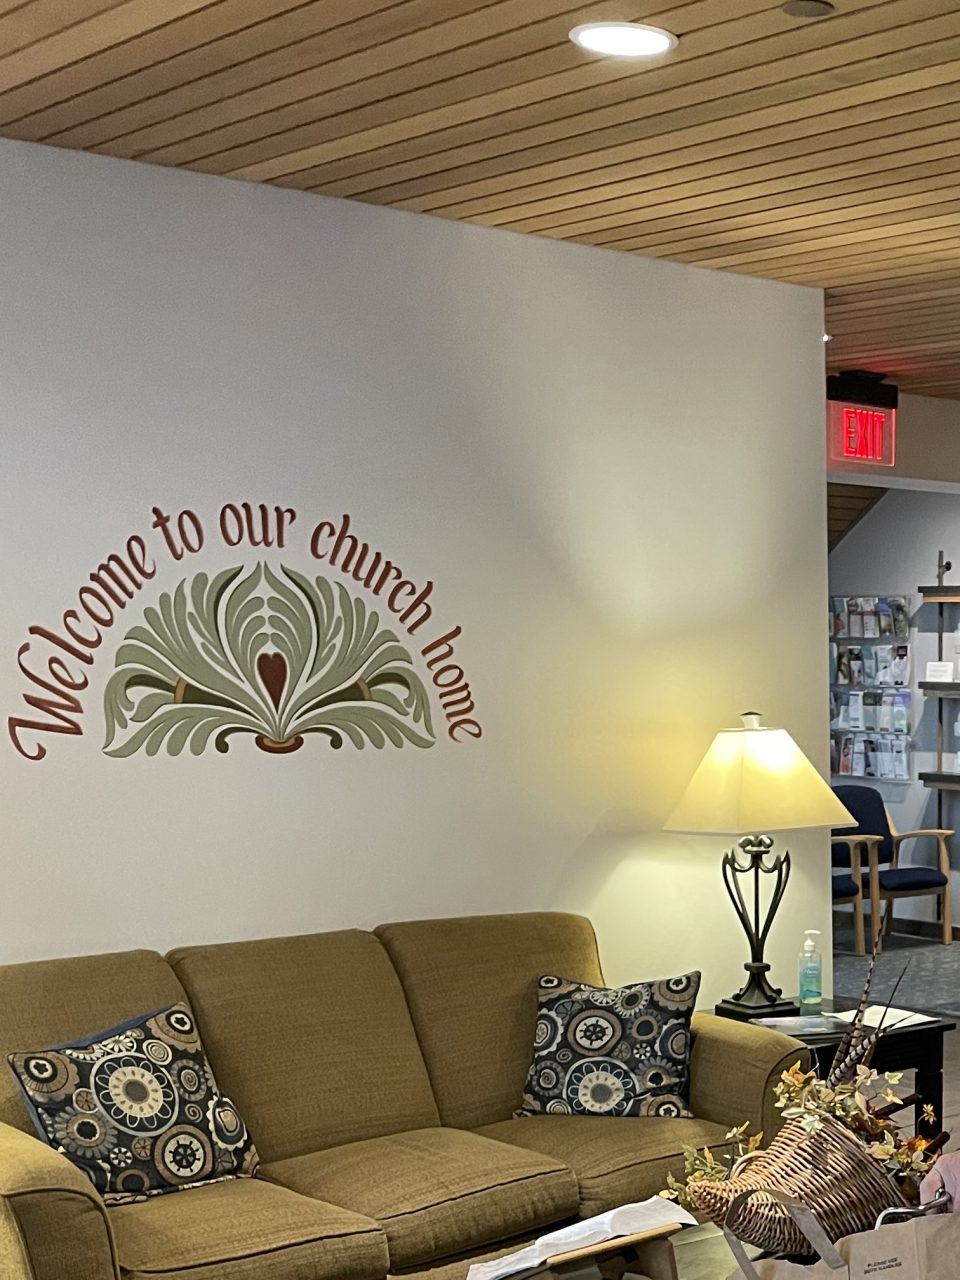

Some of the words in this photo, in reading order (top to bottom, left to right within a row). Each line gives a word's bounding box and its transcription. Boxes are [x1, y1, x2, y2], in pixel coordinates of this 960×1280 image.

[843, 408, 886, 460] EXIT
[8, 535, 157, 761] Welcome
[152, 506, 204, 561] to
[219, 502, 297, 548] our
[310, 514, 434, 636] church
[421, 625, 483, 744] home
